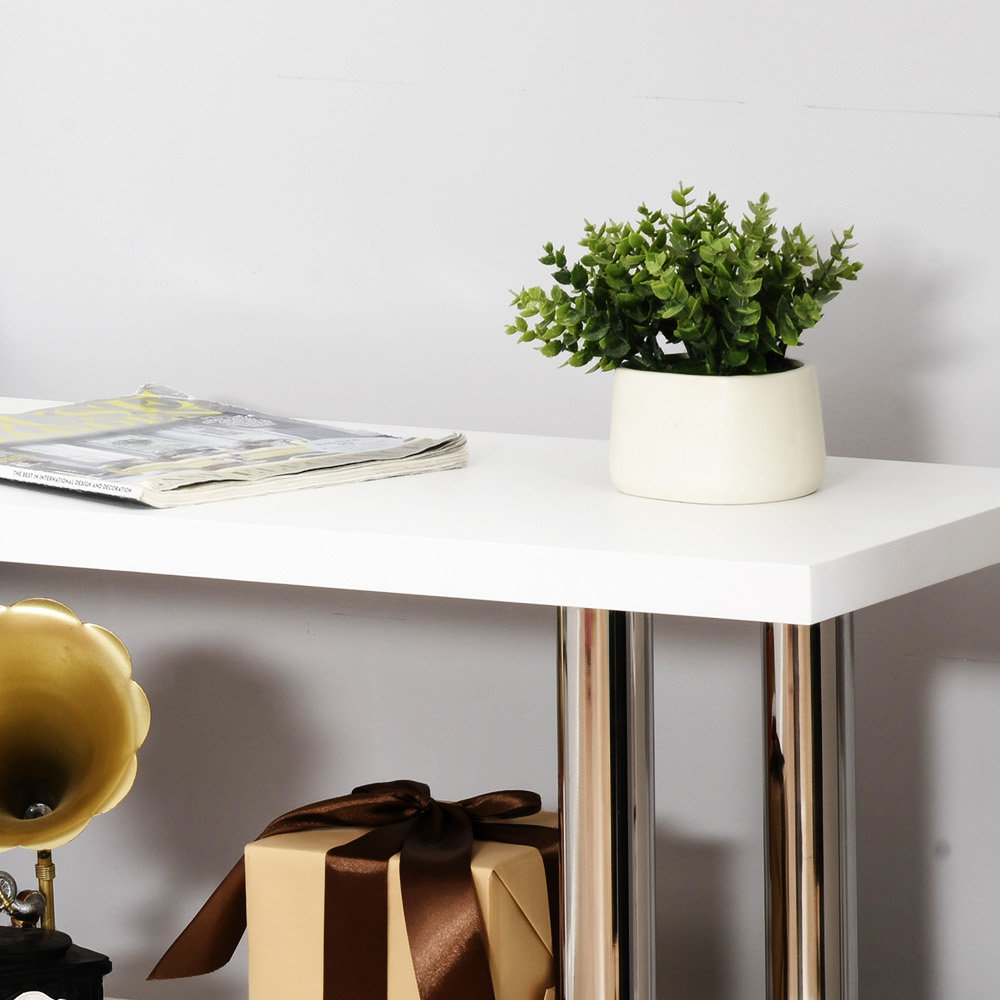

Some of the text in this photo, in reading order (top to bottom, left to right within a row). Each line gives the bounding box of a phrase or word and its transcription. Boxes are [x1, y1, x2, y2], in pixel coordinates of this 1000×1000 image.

[22, 471, 34, 479] BEST
[39, 474, 74, 486] INTERNATIONAL
[74, 479, 92, 488] DESIGN
[102, 484, 132, 493] DECORATION
